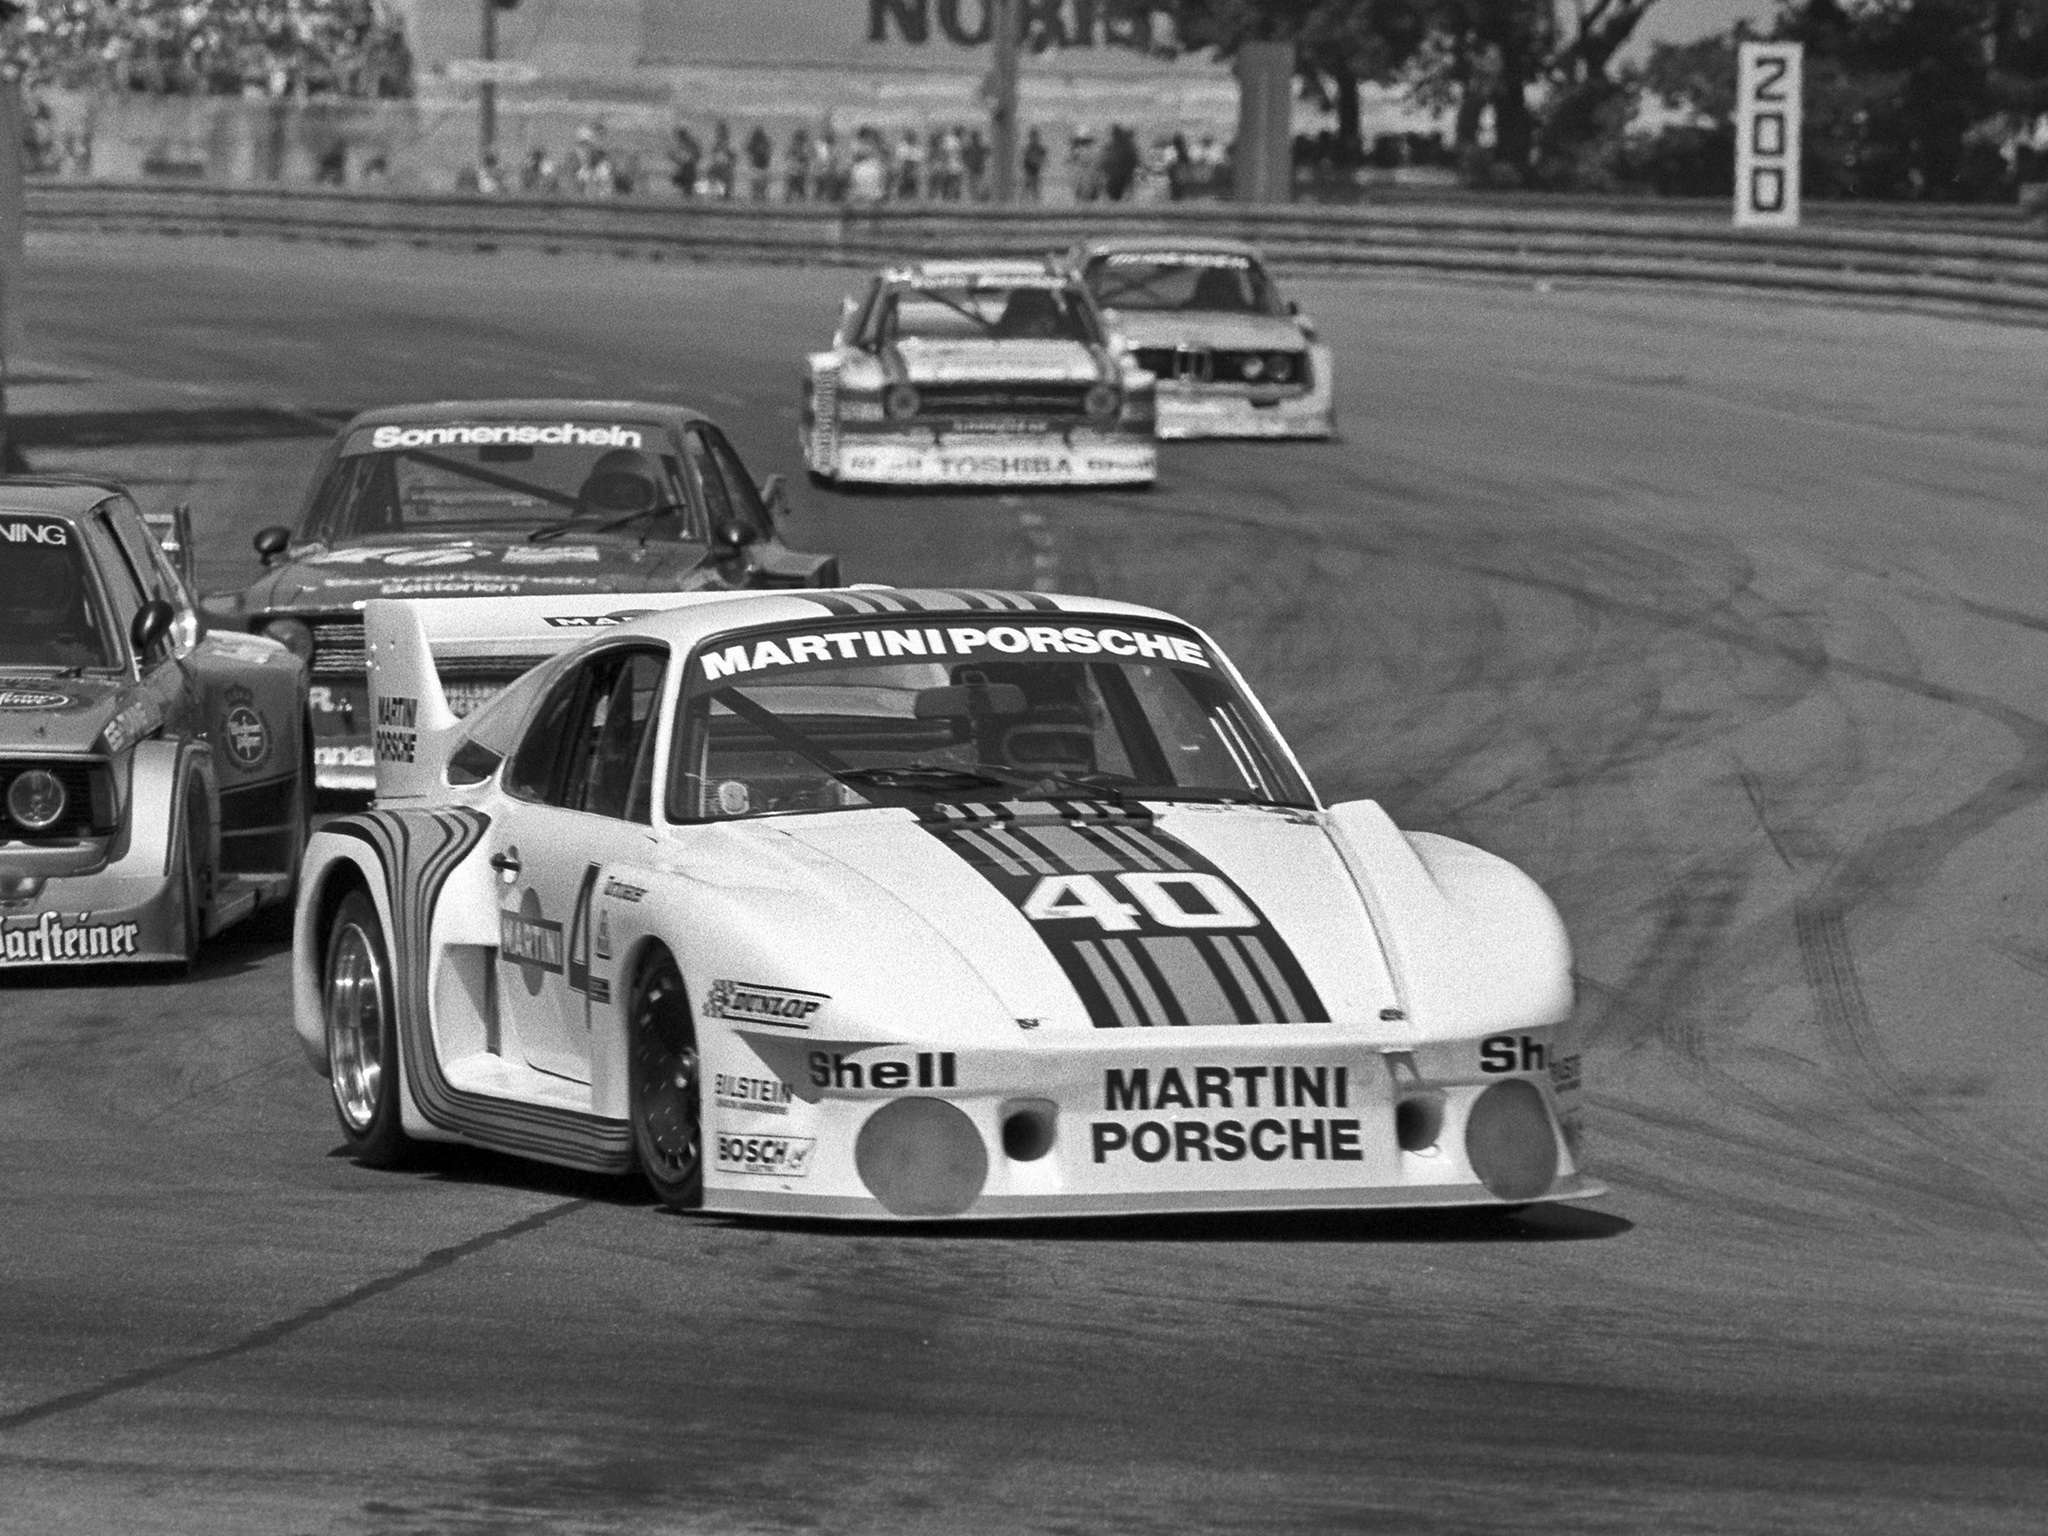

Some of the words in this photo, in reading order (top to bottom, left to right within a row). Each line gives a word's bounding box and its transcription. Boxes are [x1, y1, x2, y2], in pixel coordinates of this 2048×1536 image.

[1753, 57, 1787, 212] 200
[372, 423, 642, 448] Sonnenschein
[940, 457, 1072, 473] TOSHIBA
[700, 628, 945, 681] MARTINI
[946, 626, 1211, 669] PORSCHE
[1021, 872, 1261, 931] 40
[0, 910, 139, 962] arsteiner
[731, 991, 821, 1019] DUNLOP
[715, 1073, 792, 1104] BILSTEIN
[809, 1050, 957, 1089] Shell
[1103, 1066, 1349, 1112] MARTINI
[719, 1137, 788, 1164] BOSCH
[1091, 1118, 1364, 1164] PORSCHE
